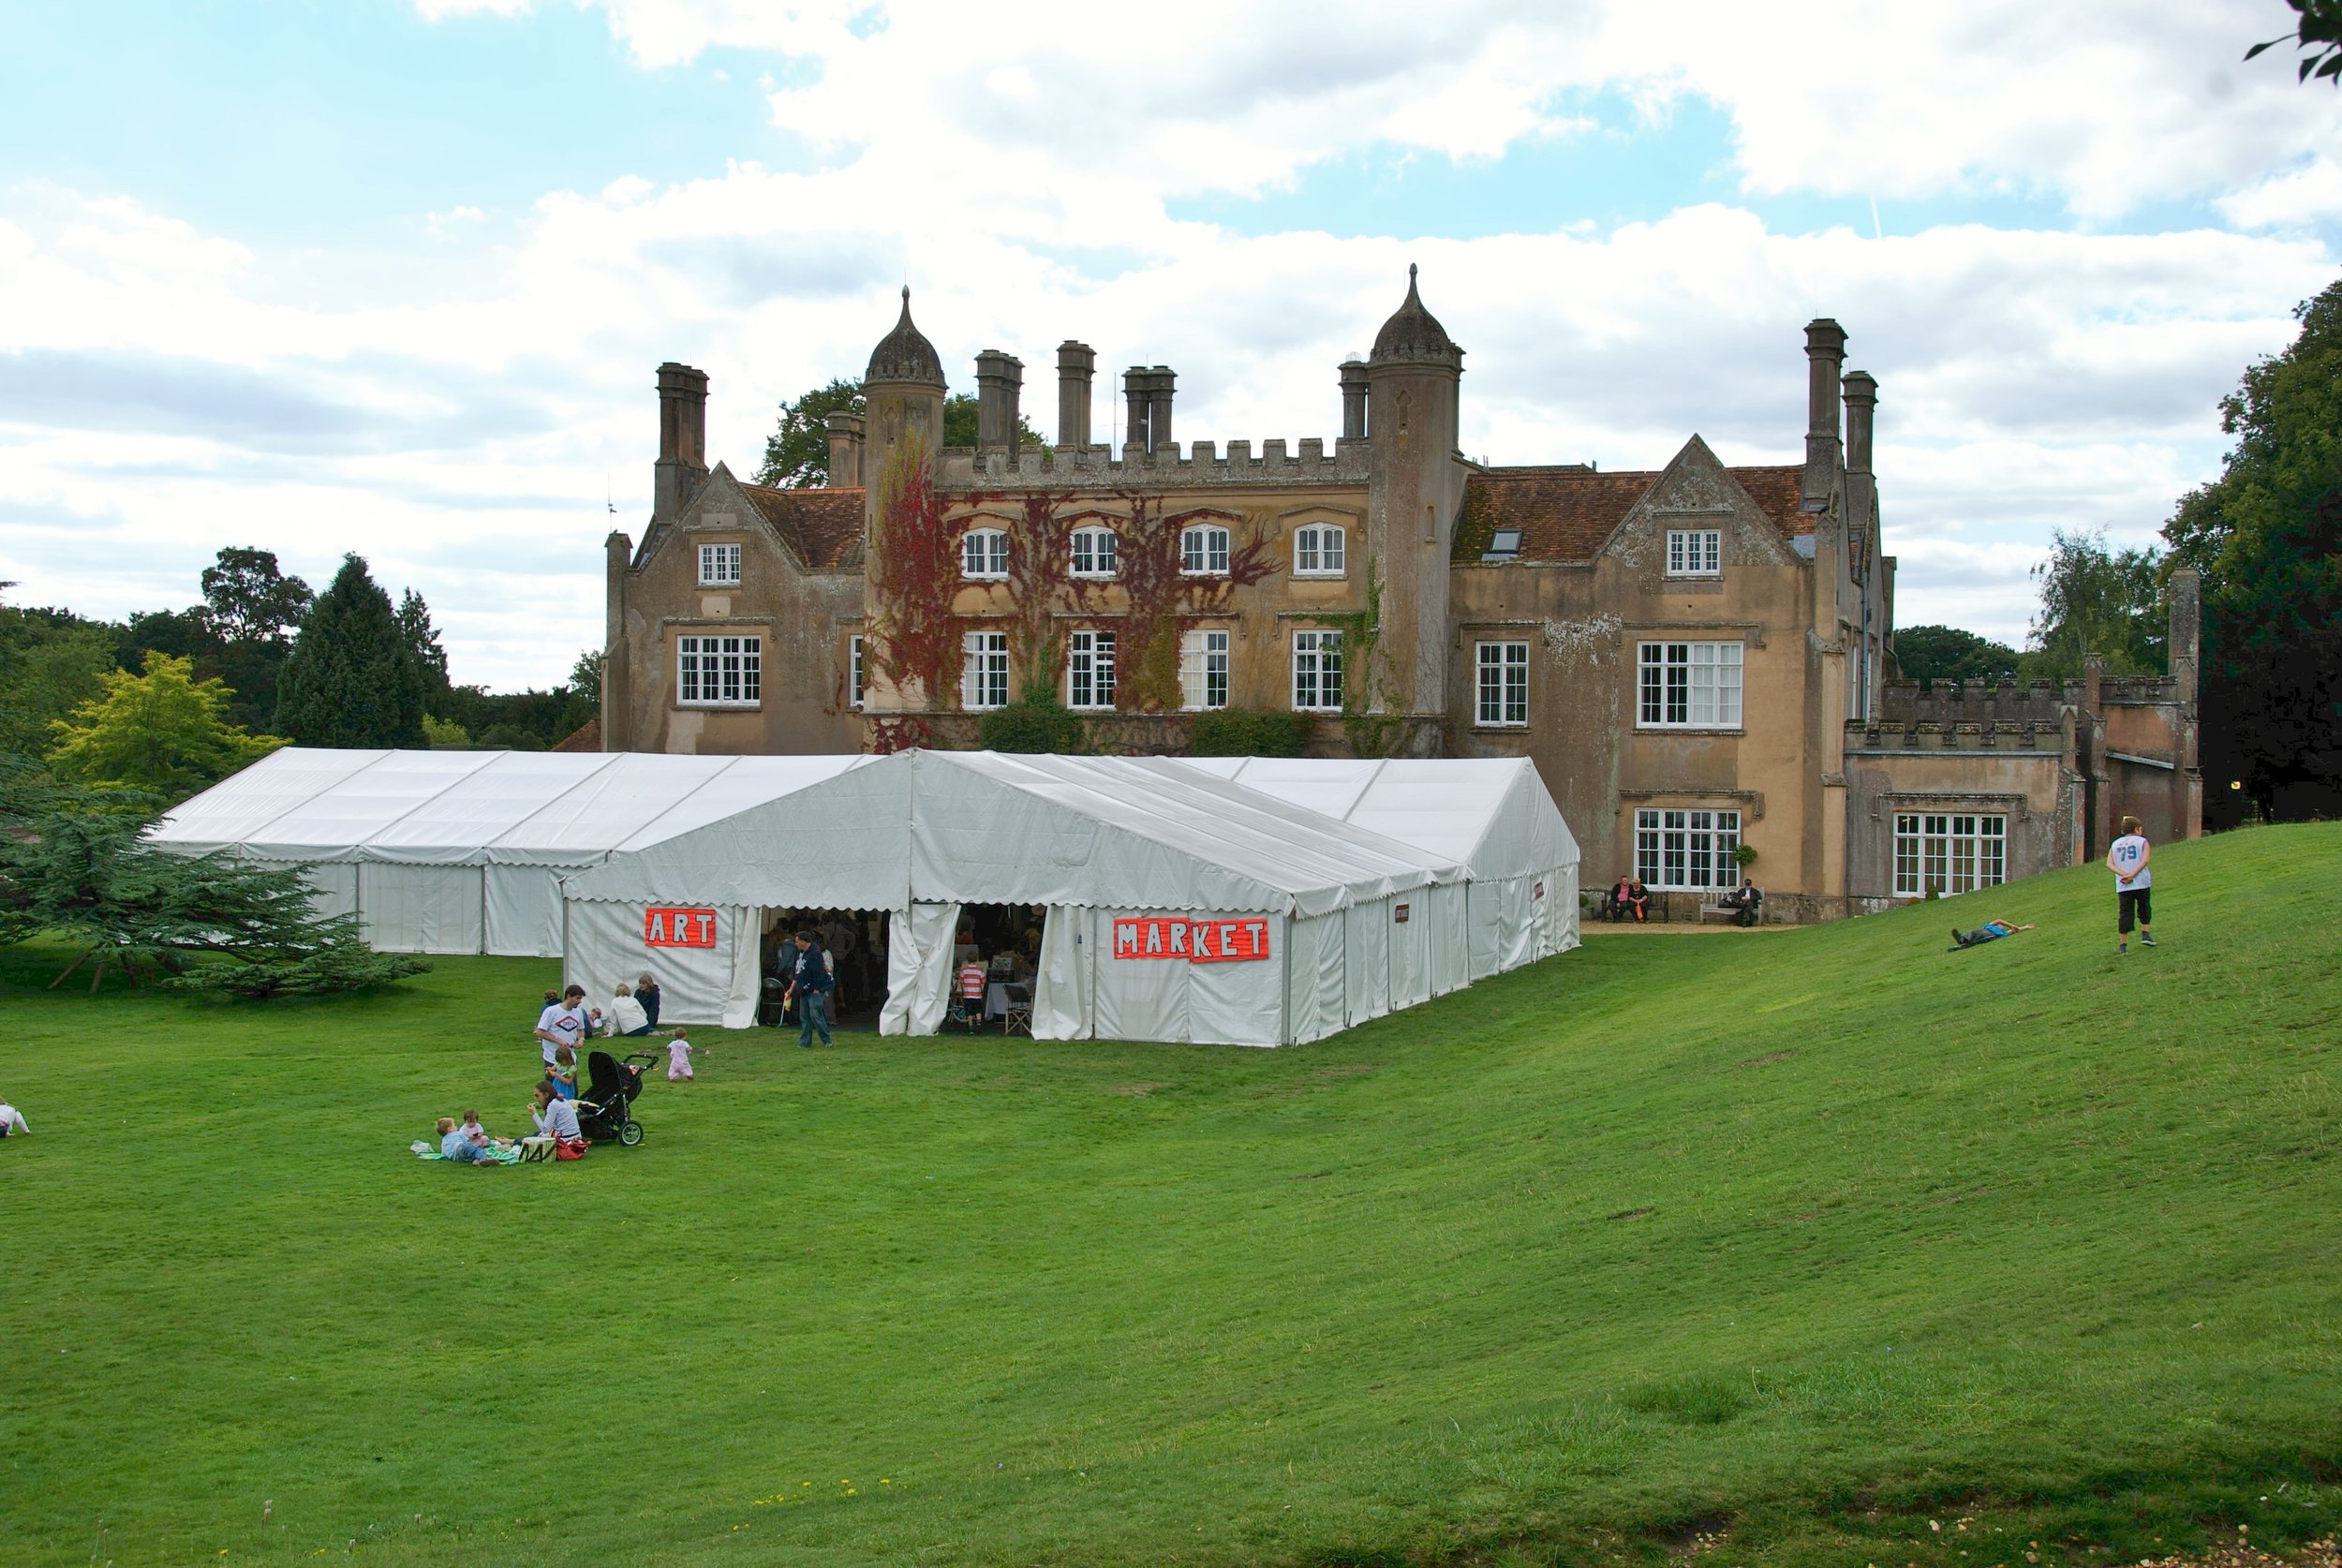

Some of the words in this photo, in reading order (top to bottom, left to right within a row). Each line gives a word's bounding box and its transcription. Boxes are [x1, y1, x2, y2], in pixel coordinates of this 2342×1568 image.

[2116, 845, 2138, 862] 79
[648, 912, 713, 943] ART
[1117, 922, 1265, 958] MARKET
